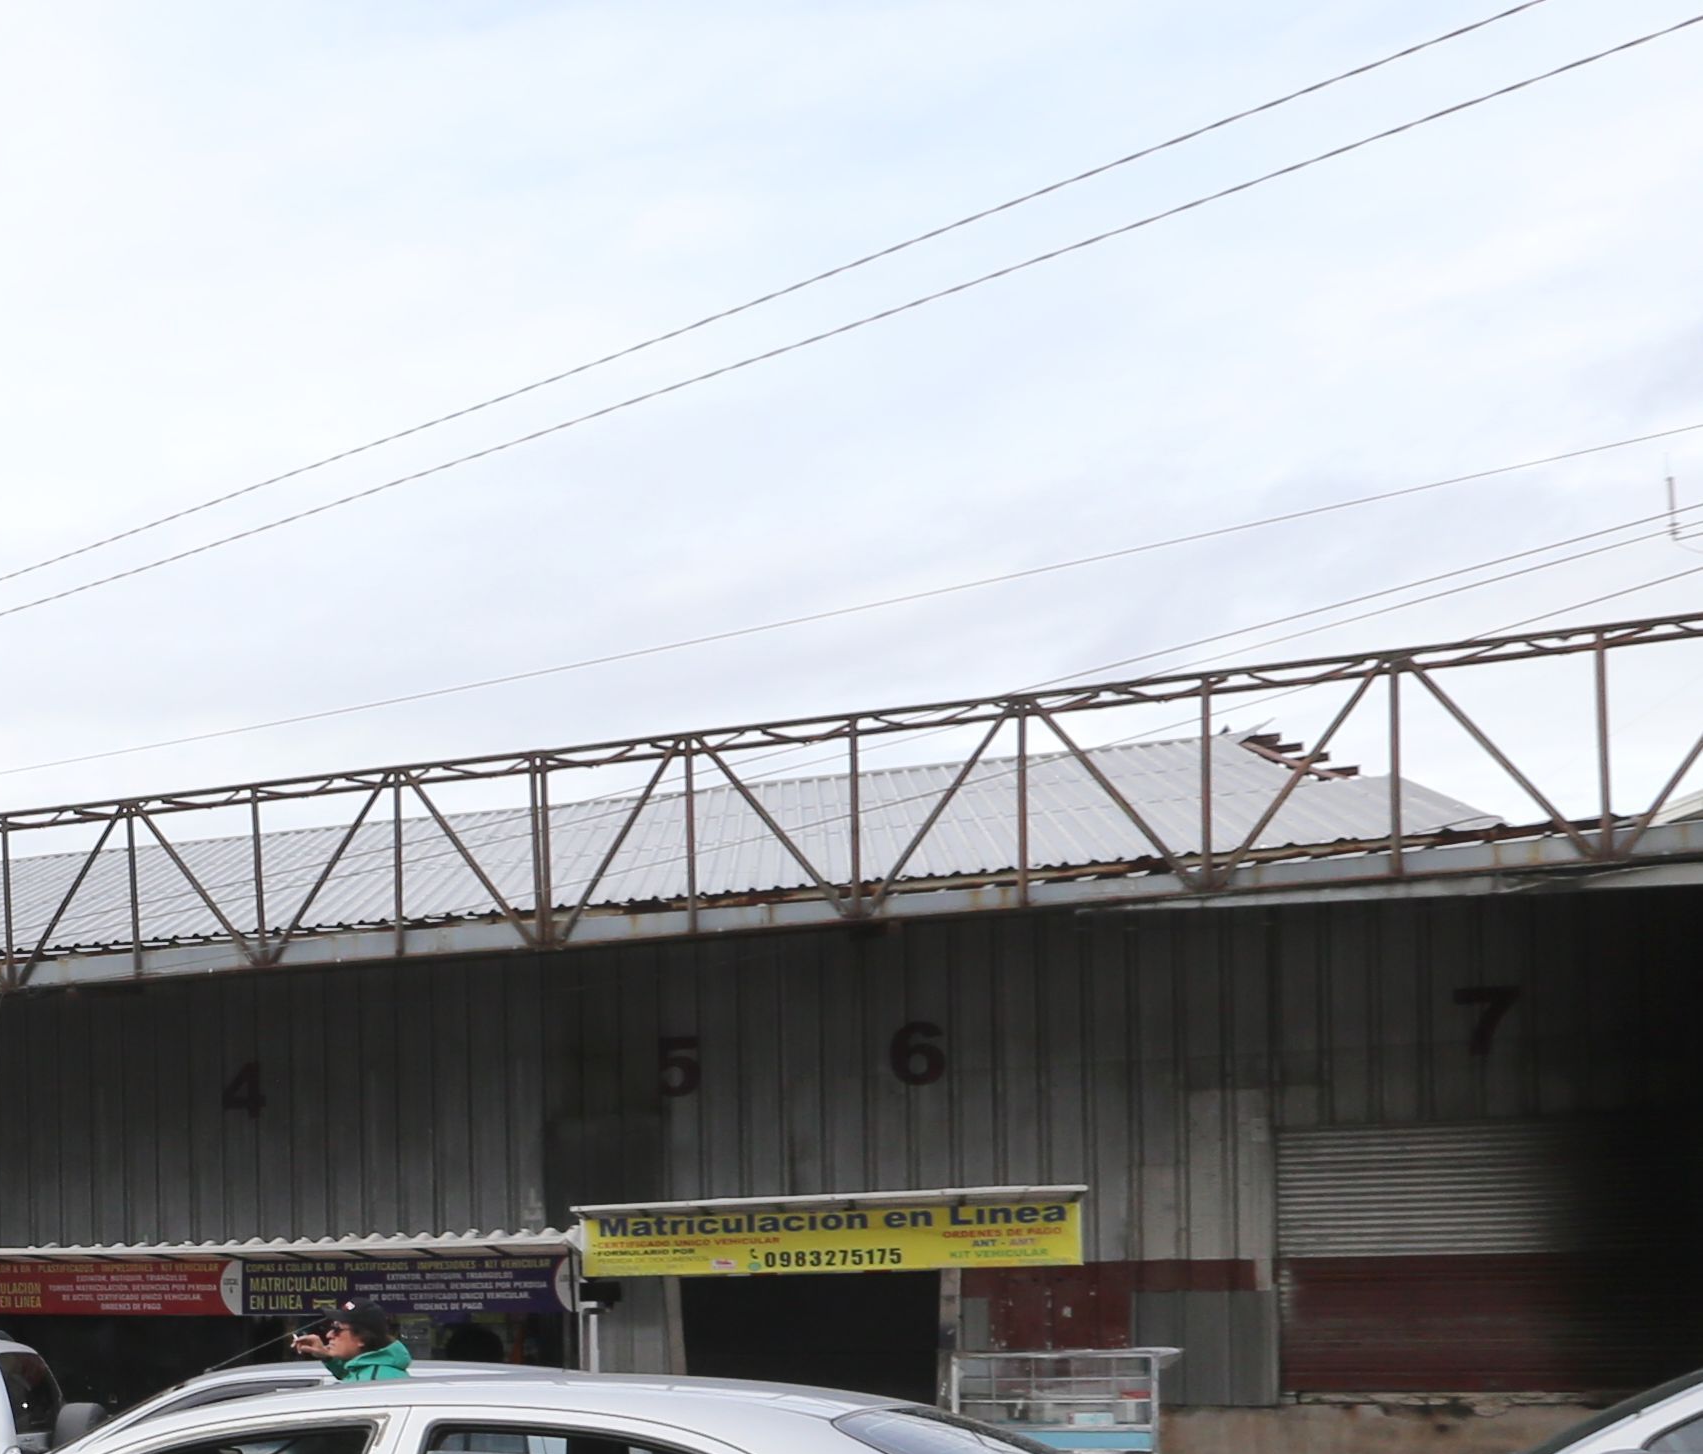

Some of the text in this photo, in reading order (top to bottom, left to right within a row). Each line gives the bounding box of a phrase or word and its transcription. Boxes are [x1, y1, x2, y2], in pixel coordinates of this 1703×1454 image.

[1454, 987, 1521, 1055] 7
[890, 1021, 945, 1085] 6
[658, 1037, 701, 1097] 5
[222, 1062, 266, 1120] 4
[883, 1210, 933, 1228] en
[942, 1226, 1062, 1238] ORDENES DE PAGO
[714, 1237, 781, 1246] VEHICULAR
[597, 1247, 696, 1257] FORMULARIO POR
[764, 1247, 902, 1268] 0983275175
[975, 1248, 1049, 1258] VEHICULAR
[250, 1276, 348, 1292] MATRICULACION
[250, 1295, 303, 1310] EN LINEA
